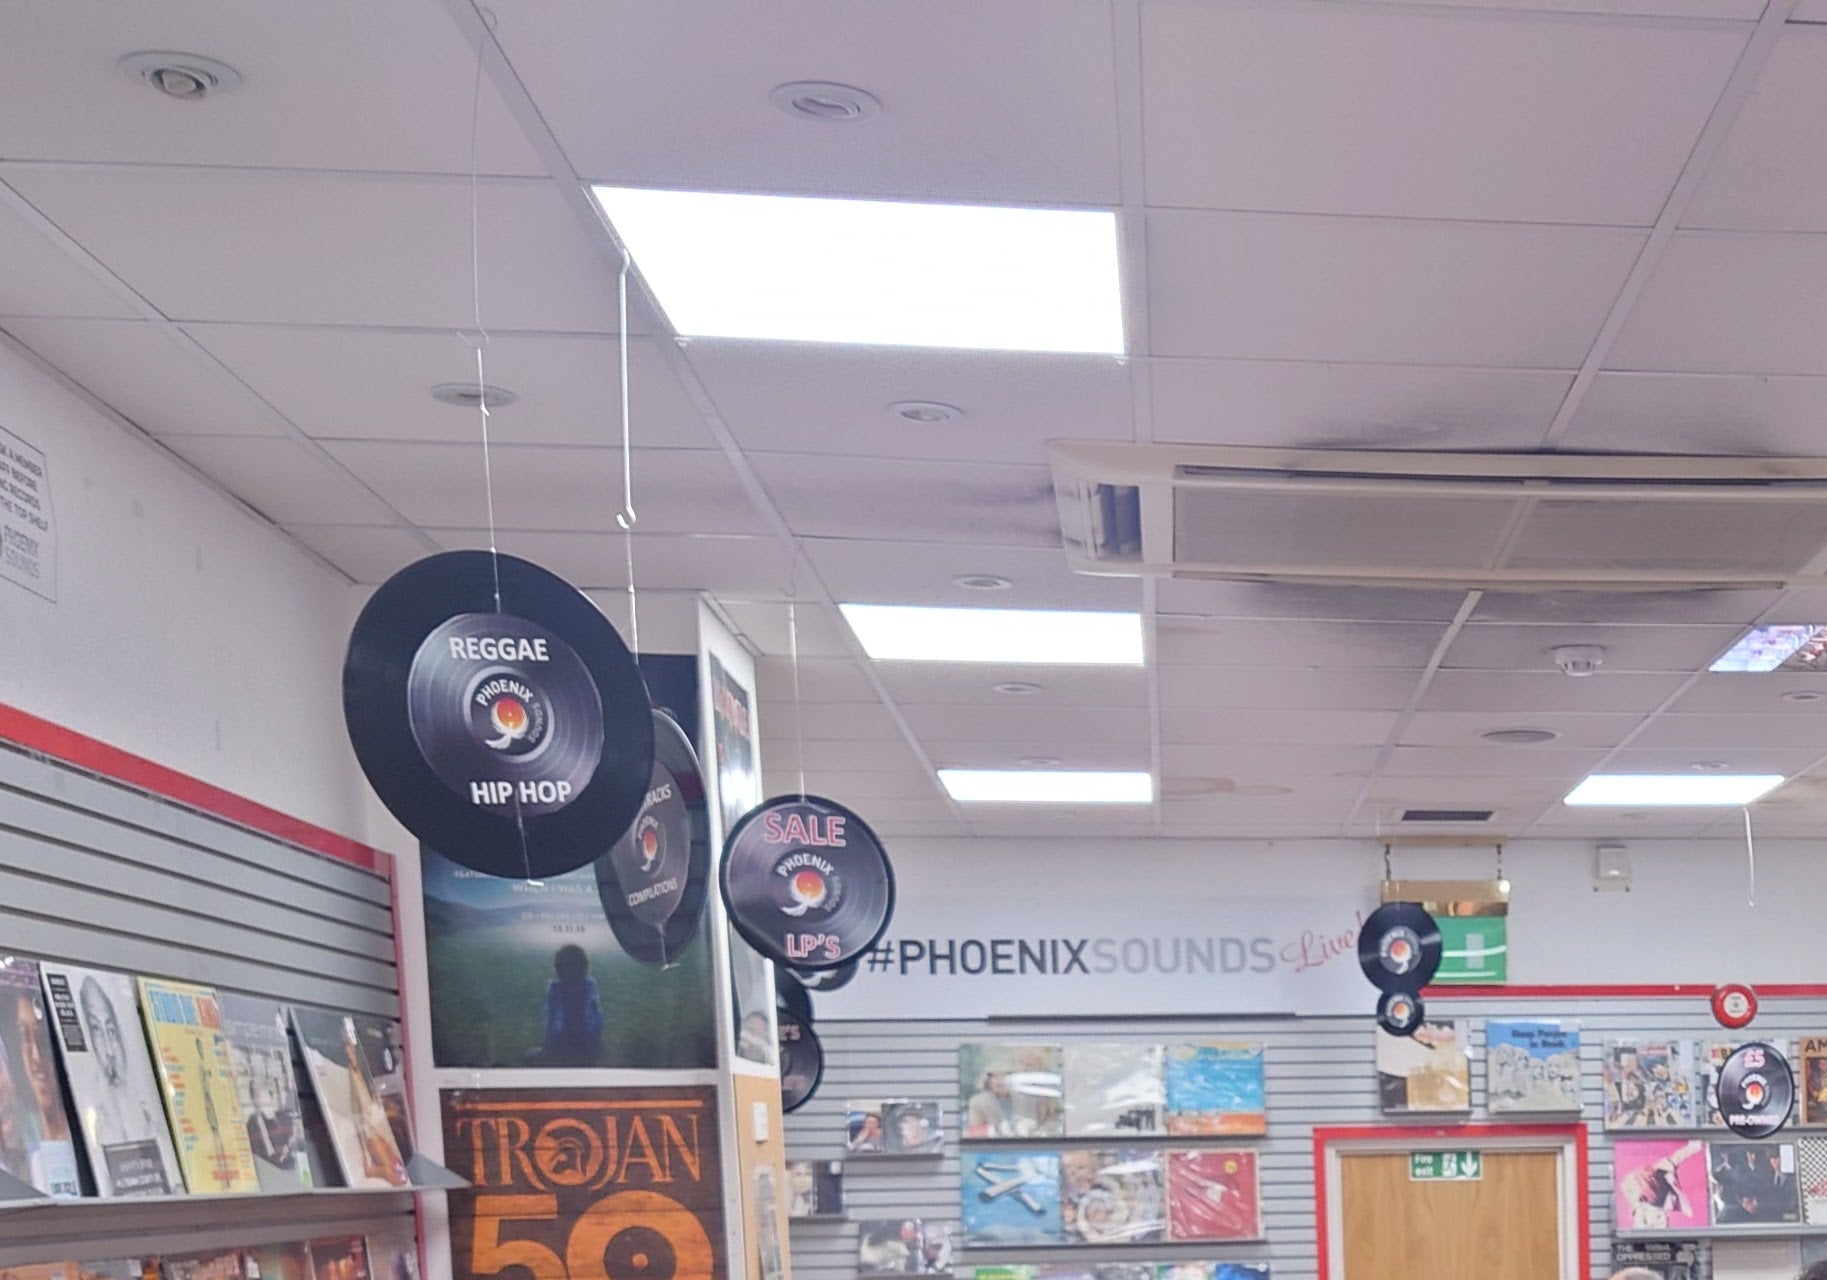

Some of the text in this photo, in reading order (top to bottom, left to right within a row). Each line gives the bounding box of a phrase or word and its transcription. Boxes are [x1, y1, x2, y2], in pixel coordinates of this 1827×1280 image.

[450, 637, 550, 661] REGGAE
[475, 679, 534, 707] PHOENIX
[469, 780, 573, 805] HIP HOP
[764, 812, 847, 848] SALE
[776, 852, 835, 878] PHOENIX
[628, 877, 679, 907] COMPILATIONS
[786, 932, 842, 960] LP'S
[456, 1114, 701, 1192] TROJAN
